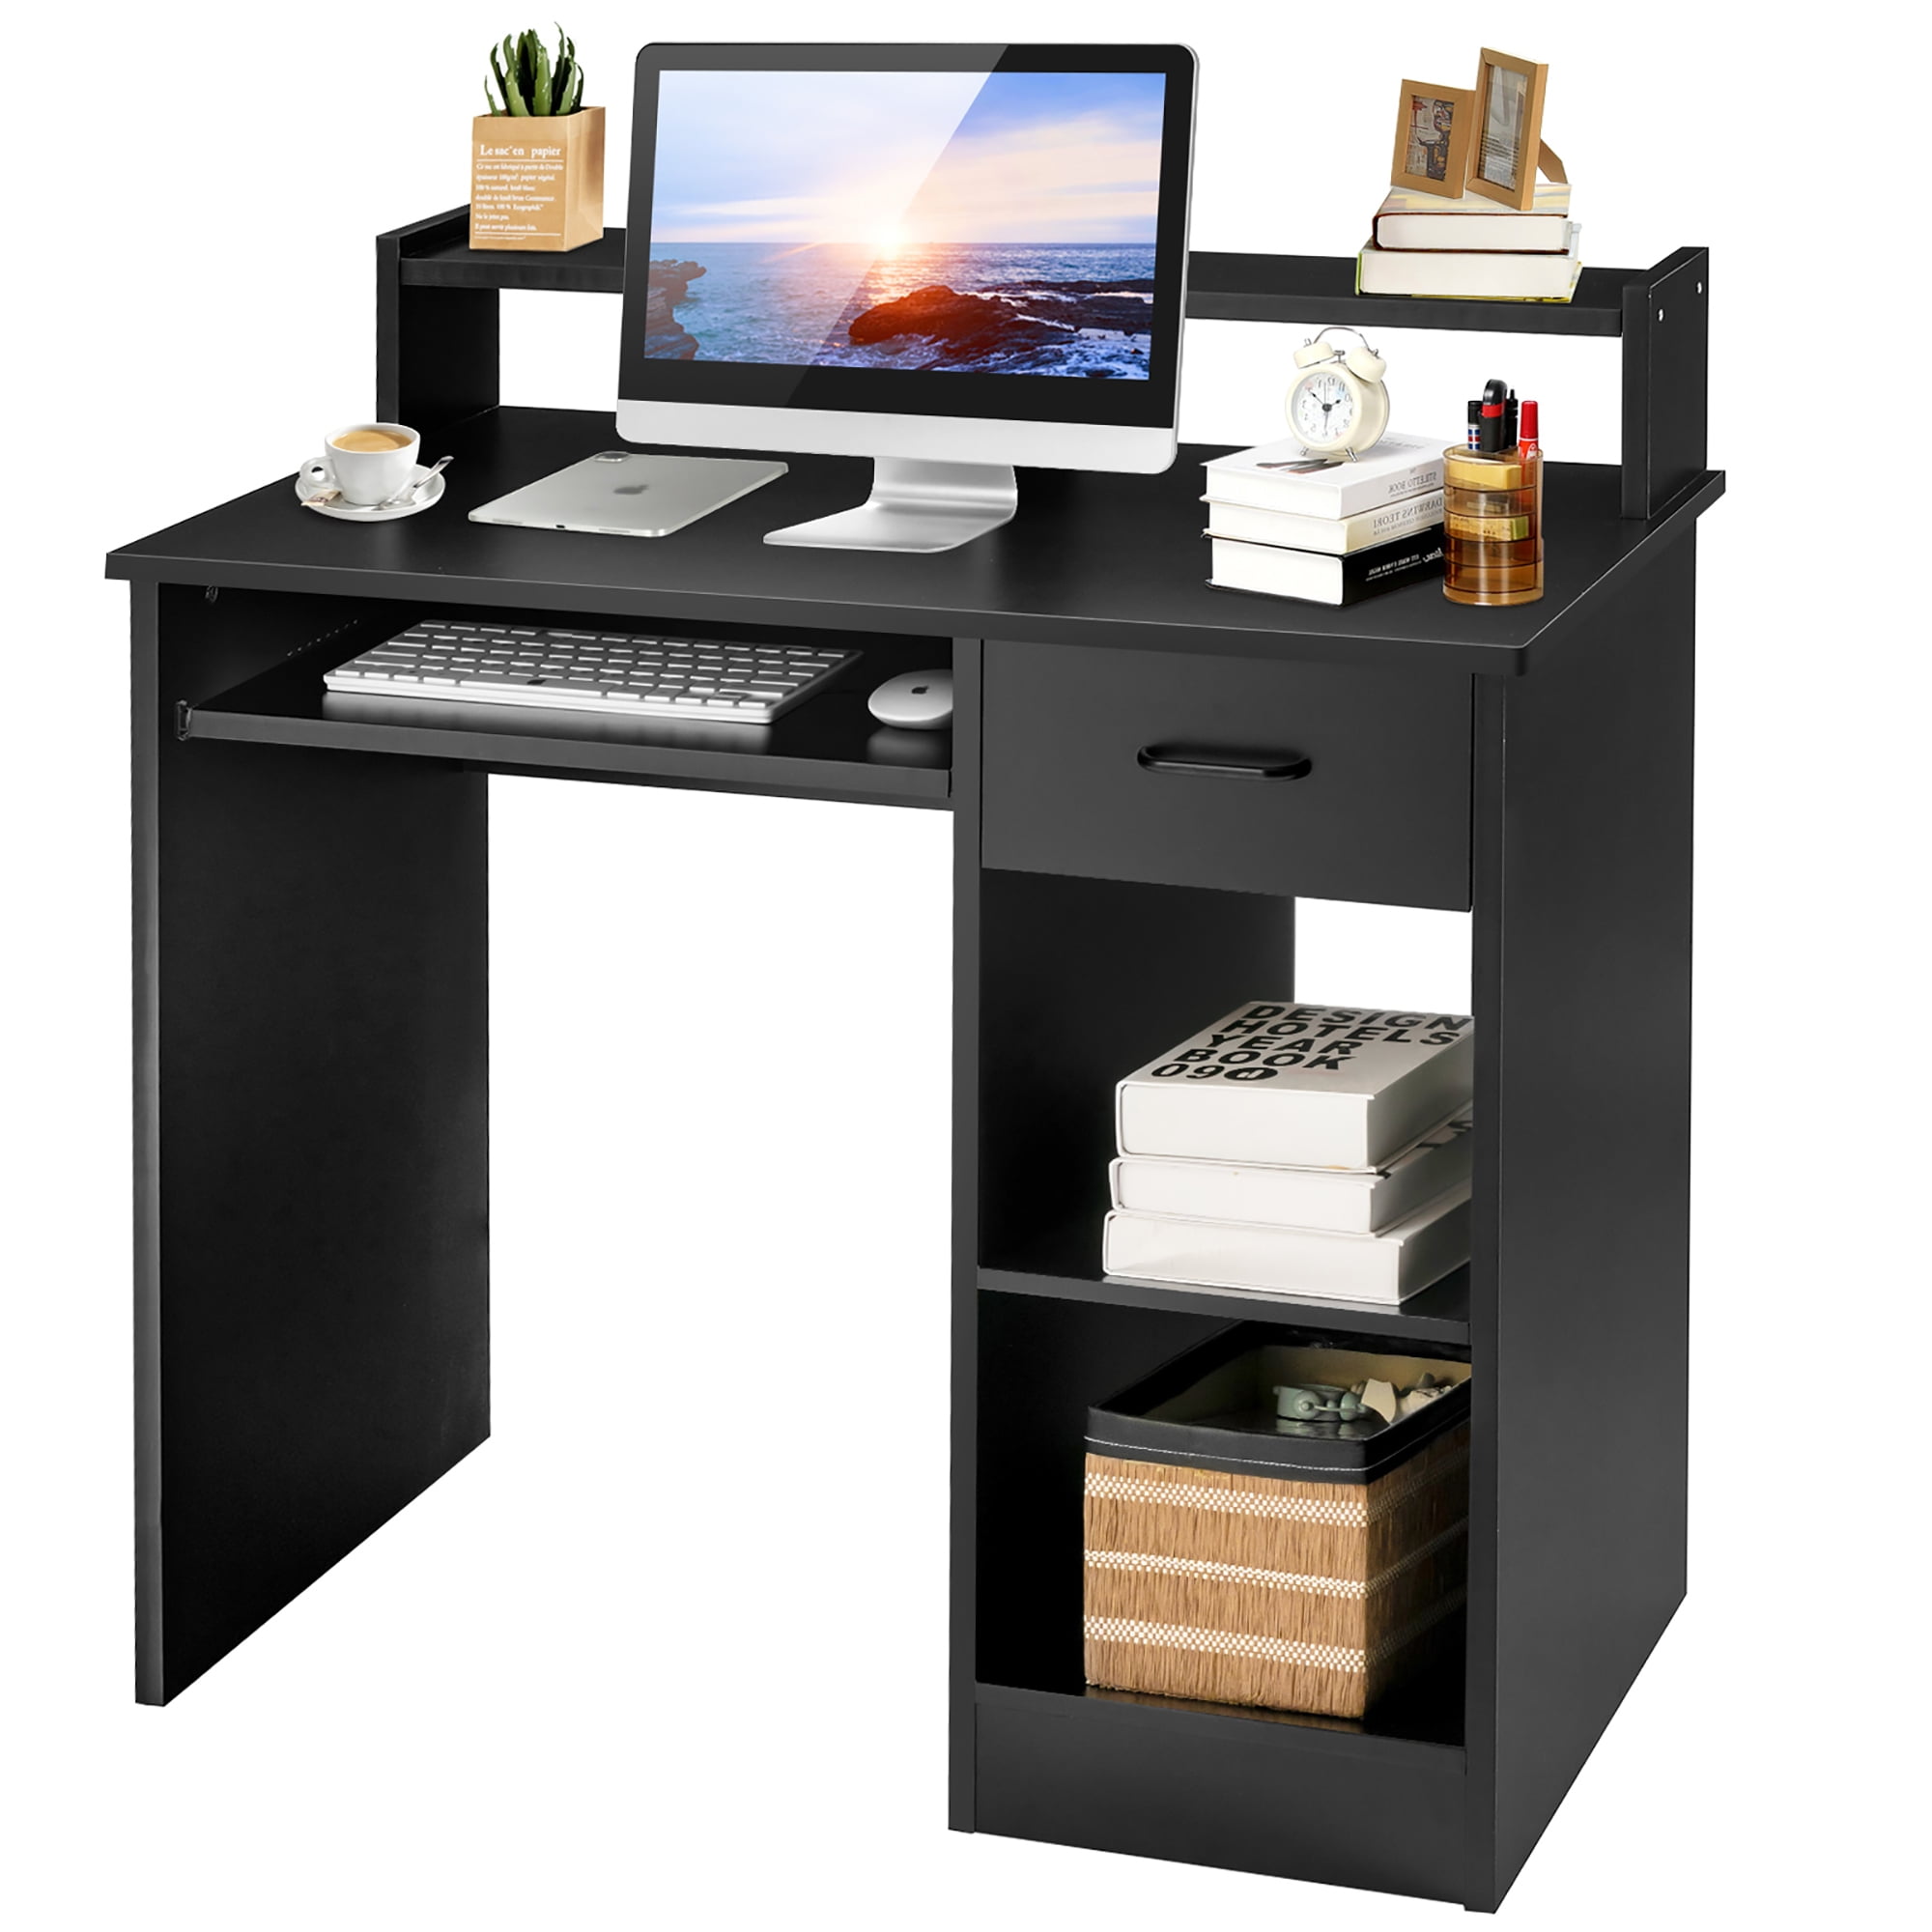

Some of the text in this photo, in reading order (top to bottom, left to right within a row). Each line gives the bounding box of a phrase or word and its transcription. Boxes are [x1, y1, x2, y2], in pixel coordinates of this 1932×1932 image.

[480, 144, 493, 156] Le
[530, 146, 561, 158] papier
[1242, 1005, 1472, 1031] DESIGN
[1222, 1020, 1460, 1045] HOTELS
[1206, 1035, 1363, 1055] YEAR
[1174, 1049, 1357, 1069] BOOK
